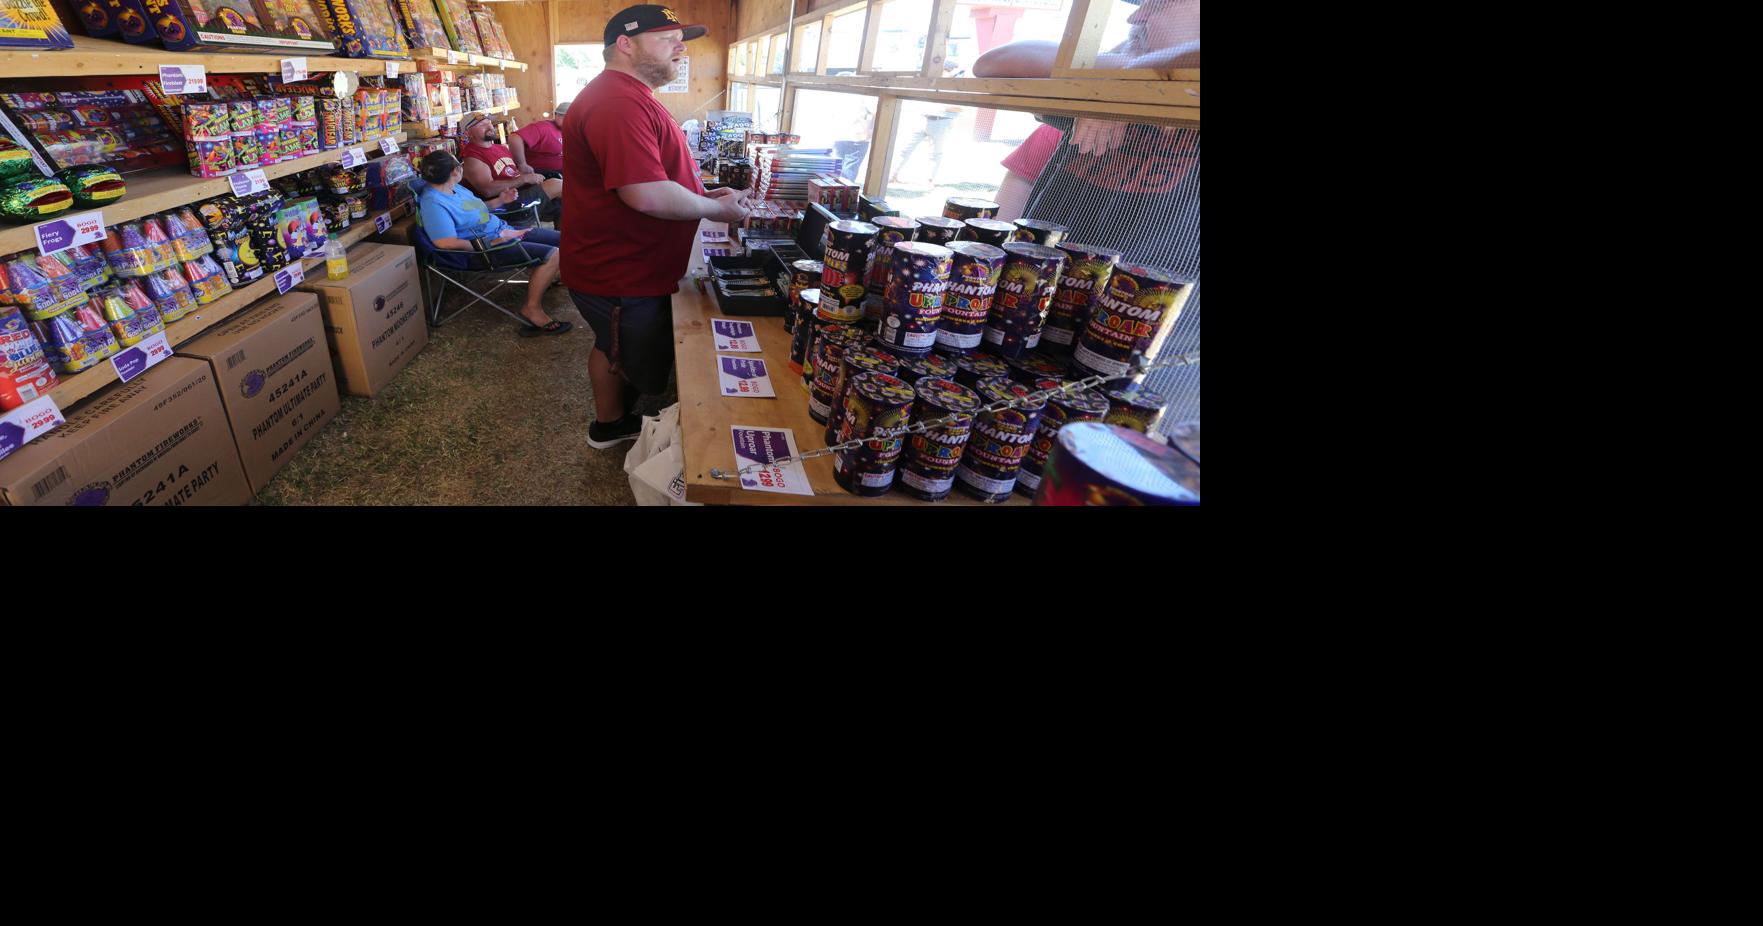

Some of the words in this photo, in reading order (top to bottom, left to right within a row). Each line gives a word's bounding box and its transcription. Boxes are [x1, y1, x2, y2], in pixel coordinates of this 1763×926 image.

[41, 230, 60, 240] Fiery
[76, 219, 97, 228] BOGO
[43, 236, 63, 246] Frogs
[372, 324, 394, 350] PHANTOM
[268, 370, 308, 403] 45241A
[25, 408, 52, 424] BOGO
[252, 407, 284, 440] PHANTOM
[283, 384, 311, 416] ULTIMATE
[309, 372, 327, 392] PARTY
[57, 418, 90, 439] KEEP
[92, 403, 118, 419] FIRE
[272, 437, 295, 461] MADE
[294, 429, 303, 440] IN
[303, 408, 326, 431] CHINA
[112, 449, 154, 482] PHANTOM
[155, 417, 200, 452] FIREWORKS
[746, 430, 758, 456] Uproar
[762, 431, 776, 463] Phantom
[192, 461, 221, 495] PARTY
[772, 467, 786, 488] BOGO
